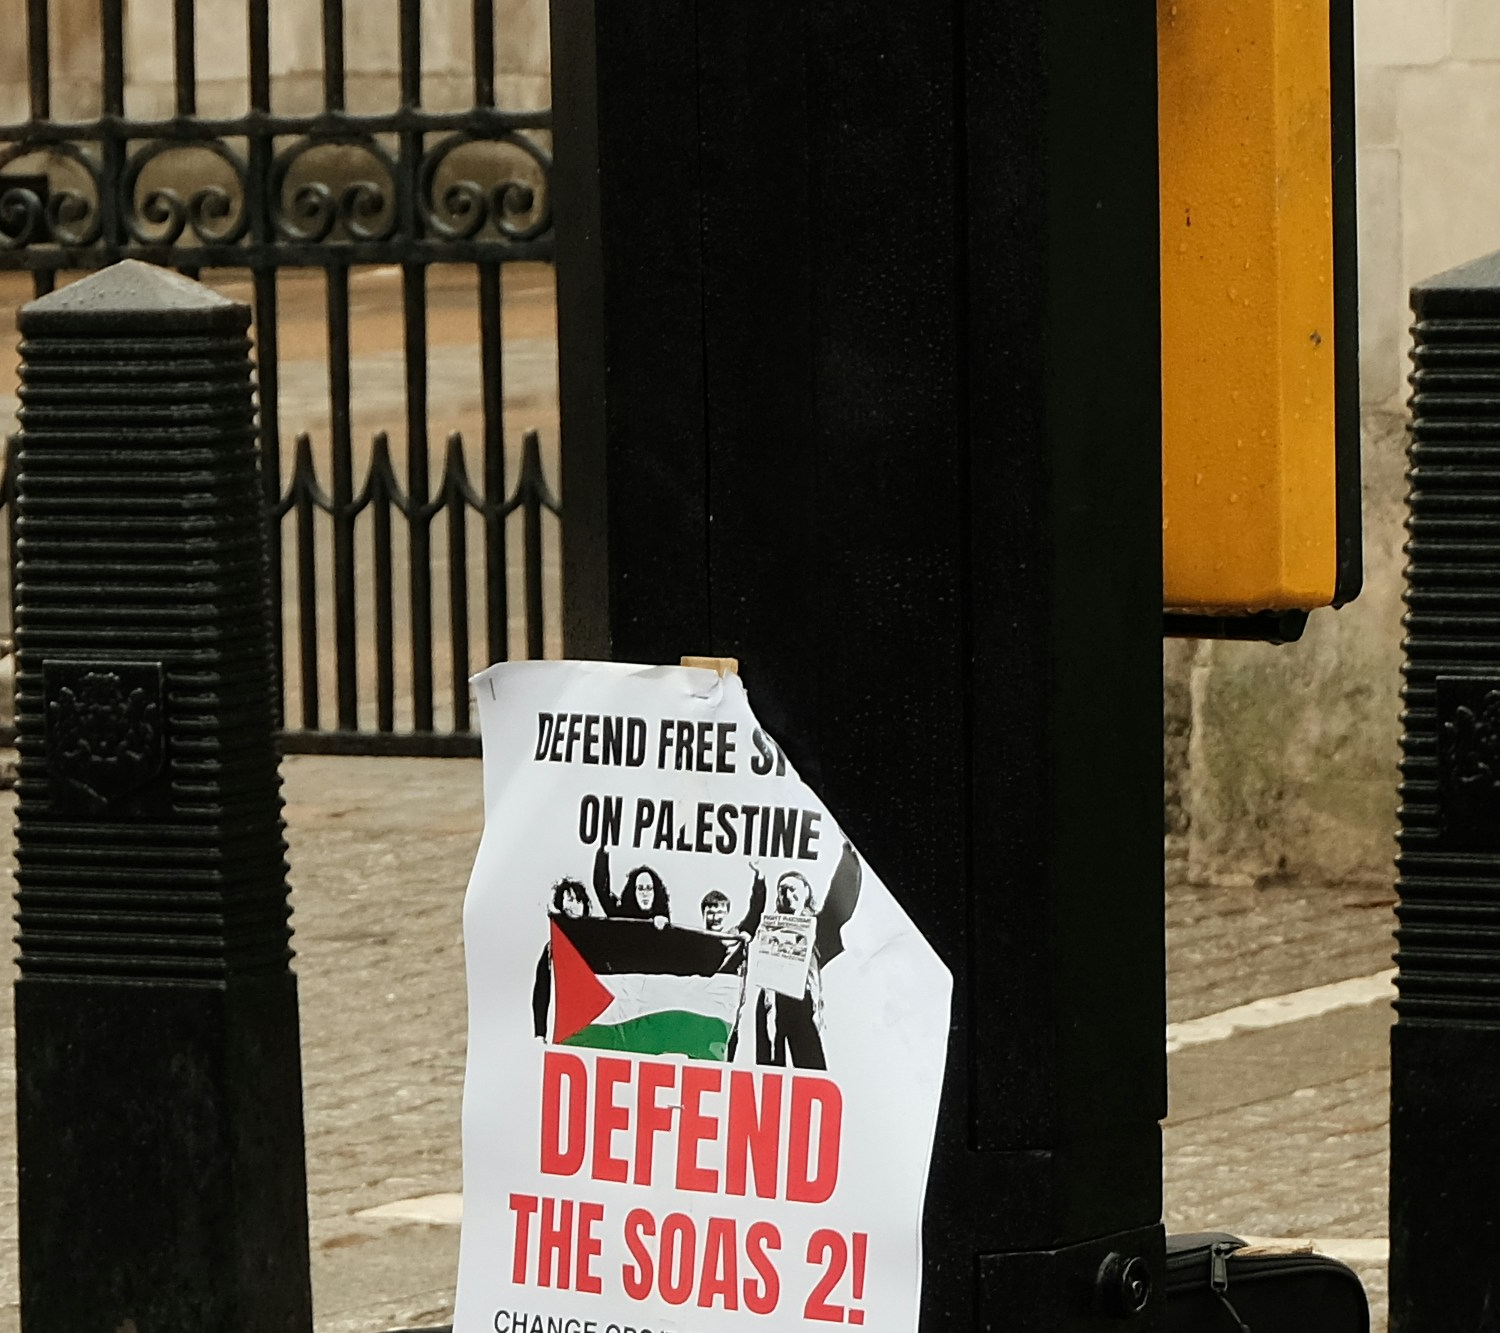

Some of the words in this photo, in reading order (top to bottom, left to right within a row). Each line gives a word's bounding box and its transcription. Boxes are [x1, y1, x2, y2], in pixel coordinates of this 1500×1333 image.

[533, 712, 647, 768] DEFEND
[657, 718, 737, 774] FREE
[578, 794, 623, 847] ON
[632, 797, 822, 861] PALESTINE
[540, 1050, 843, 1204] DEFEND
[509, 1193, 604, 1295] THE
[621, 1208, 782, 1315] SOAS
[803, 1228, 868, 1326] 2!
